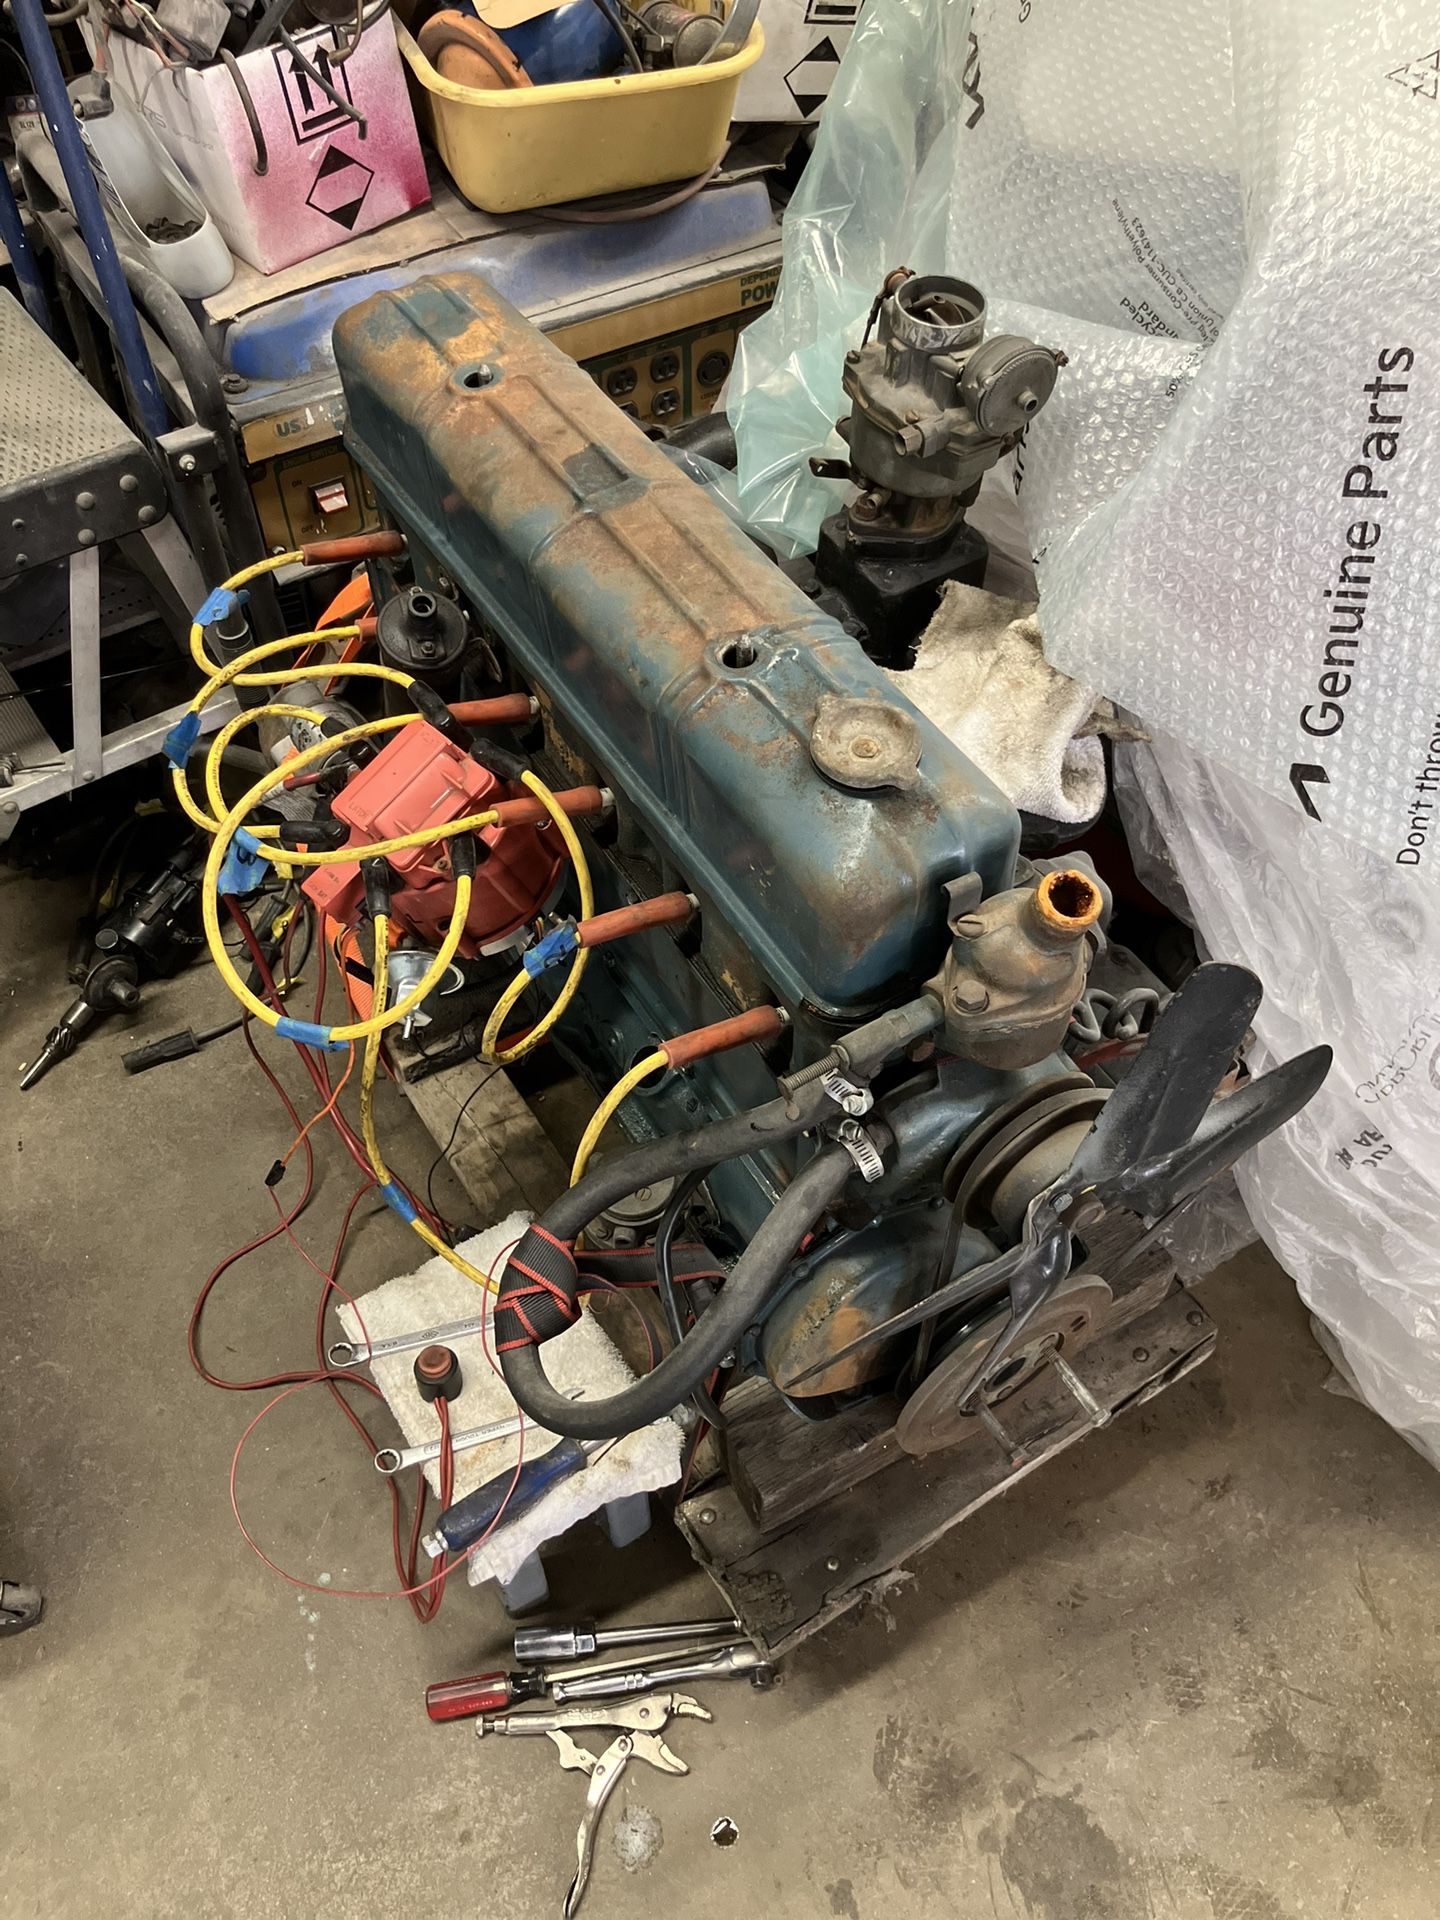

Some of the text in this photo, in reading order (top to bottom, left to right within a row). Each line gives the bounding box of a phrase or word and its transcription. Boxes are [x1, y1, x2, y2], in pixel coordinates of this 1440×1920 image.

[1300, 346, 1415, 738] Genuine Parts
[1396, 800, 1434, 866] Don't
